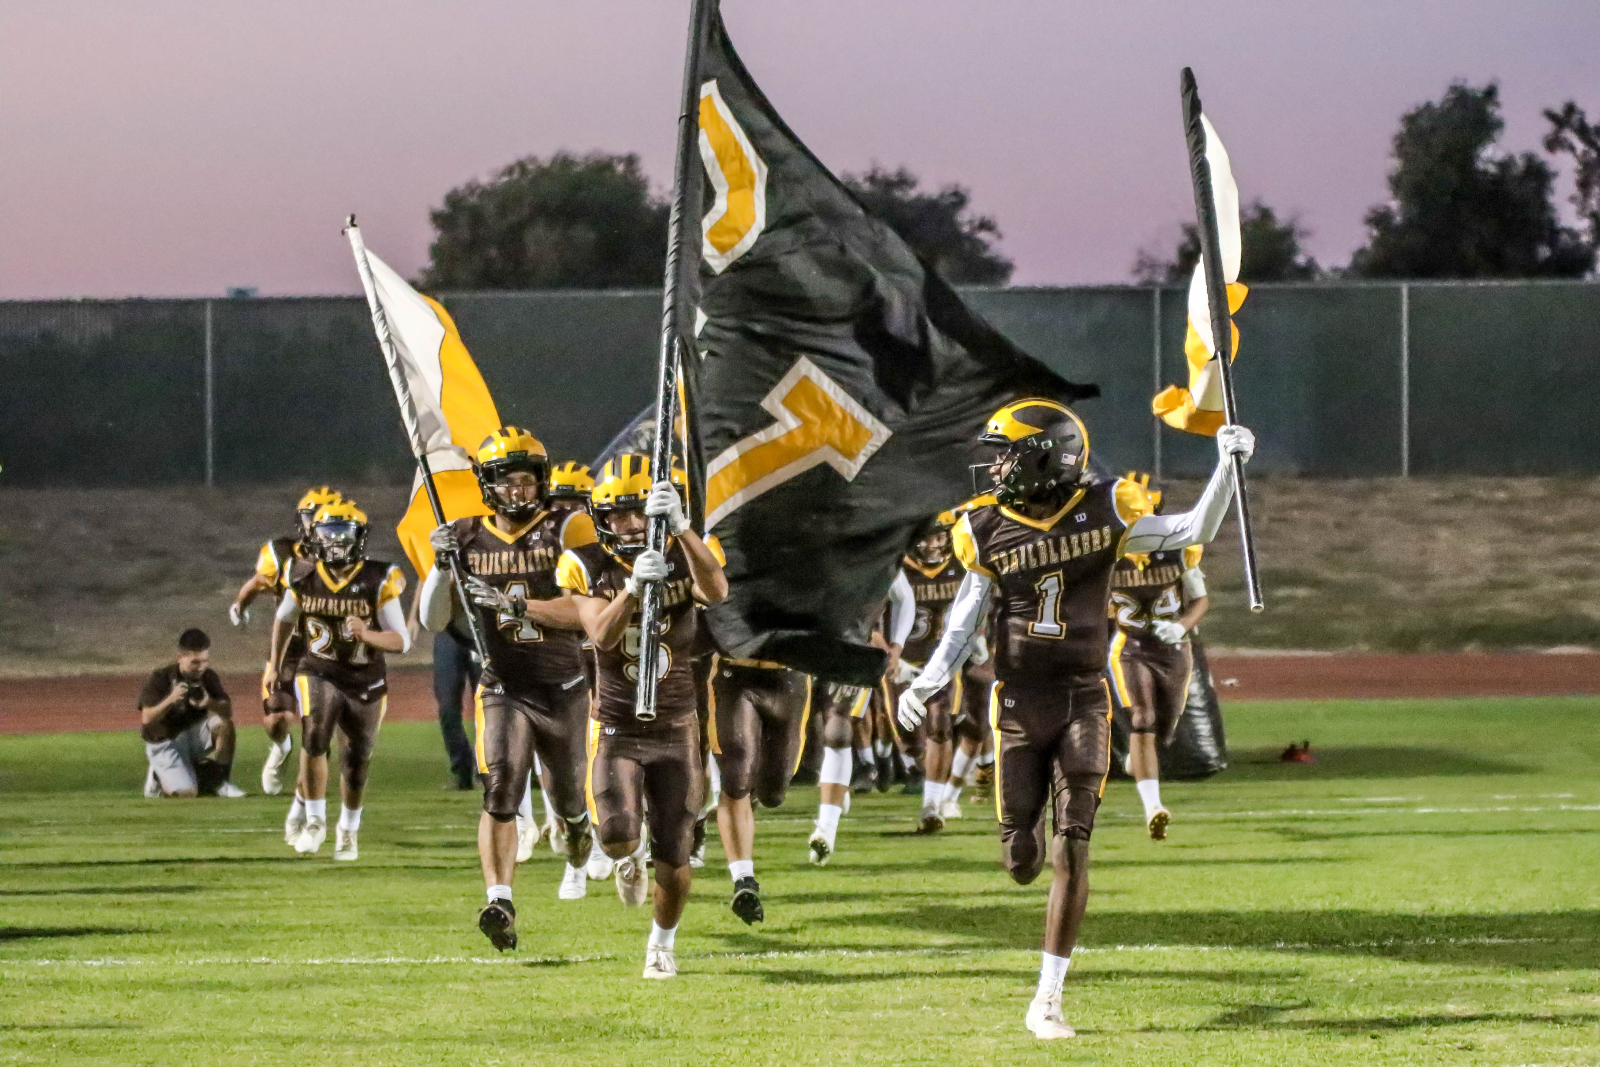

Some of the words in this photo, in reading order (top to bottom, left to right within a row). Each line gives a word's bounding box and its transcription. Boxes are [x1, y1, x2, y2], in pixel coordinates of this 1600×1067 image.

[989, 525, 1111, 575] TRAILBLAZERS
[498, 580, 544, 642] 4
[1028, 569, 1066, 640] 1
[1111, 585, 1181, 629] 24
